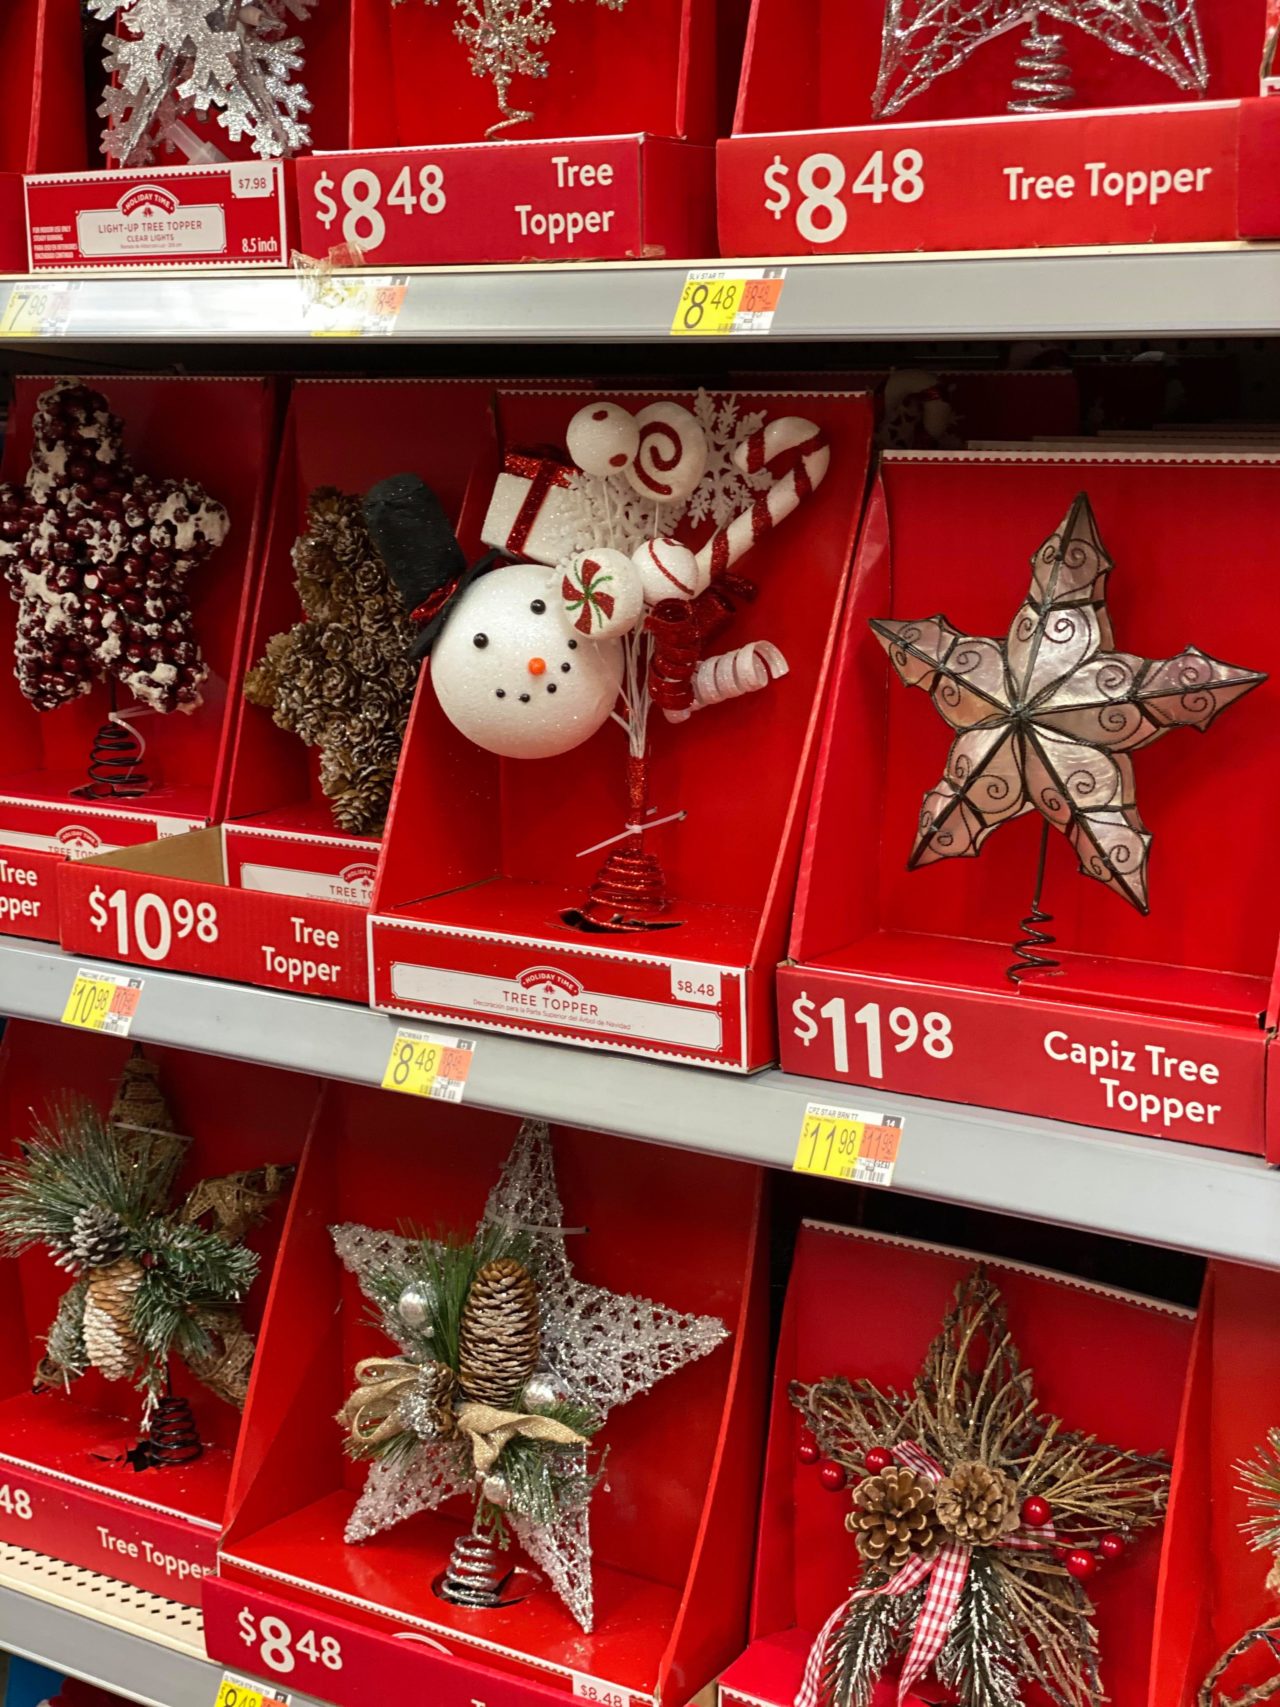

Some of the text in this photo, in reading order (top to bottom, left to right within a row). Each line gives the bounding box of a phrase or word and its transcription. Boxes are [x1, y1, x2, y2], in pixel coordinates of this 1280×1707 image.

[238, 178, 267, 189] $7.98
[551, 156, 614, 188] Tree
[1003, 162, 1211, 206] Tree Topper
[125, 193, 171, 210] HOLIDAY TIME
[98, 220, 202, 234] LIGHT-UP TREE TOPPER
[514, 205, 615, 244] Topper
[126, 233, 174, 242] CLEAR LIGHTS
[242, 236, 278, 253] 8.5 inch
[329, 885, 357, 898] TREE
[0, 896, 41, 920] pper
[290, 916, 340, 949] Tree
[261, 945, 341, 985] Topper
[525, 973, 574, 990] HOLIDAY TIME
[677, 980, 715, 997] $8.48
[502, 990, 598, 1016] TREE TOPPER
[1043, 1031, 1220, 1085] Capiz Tree
[821, 1108, 836, 1117] STAR
[1099, 1078, 1222, 1126] Topper
[0, 1484, 33, 1519] 48
[97, 1526, 211, 1580] Tree Topper
